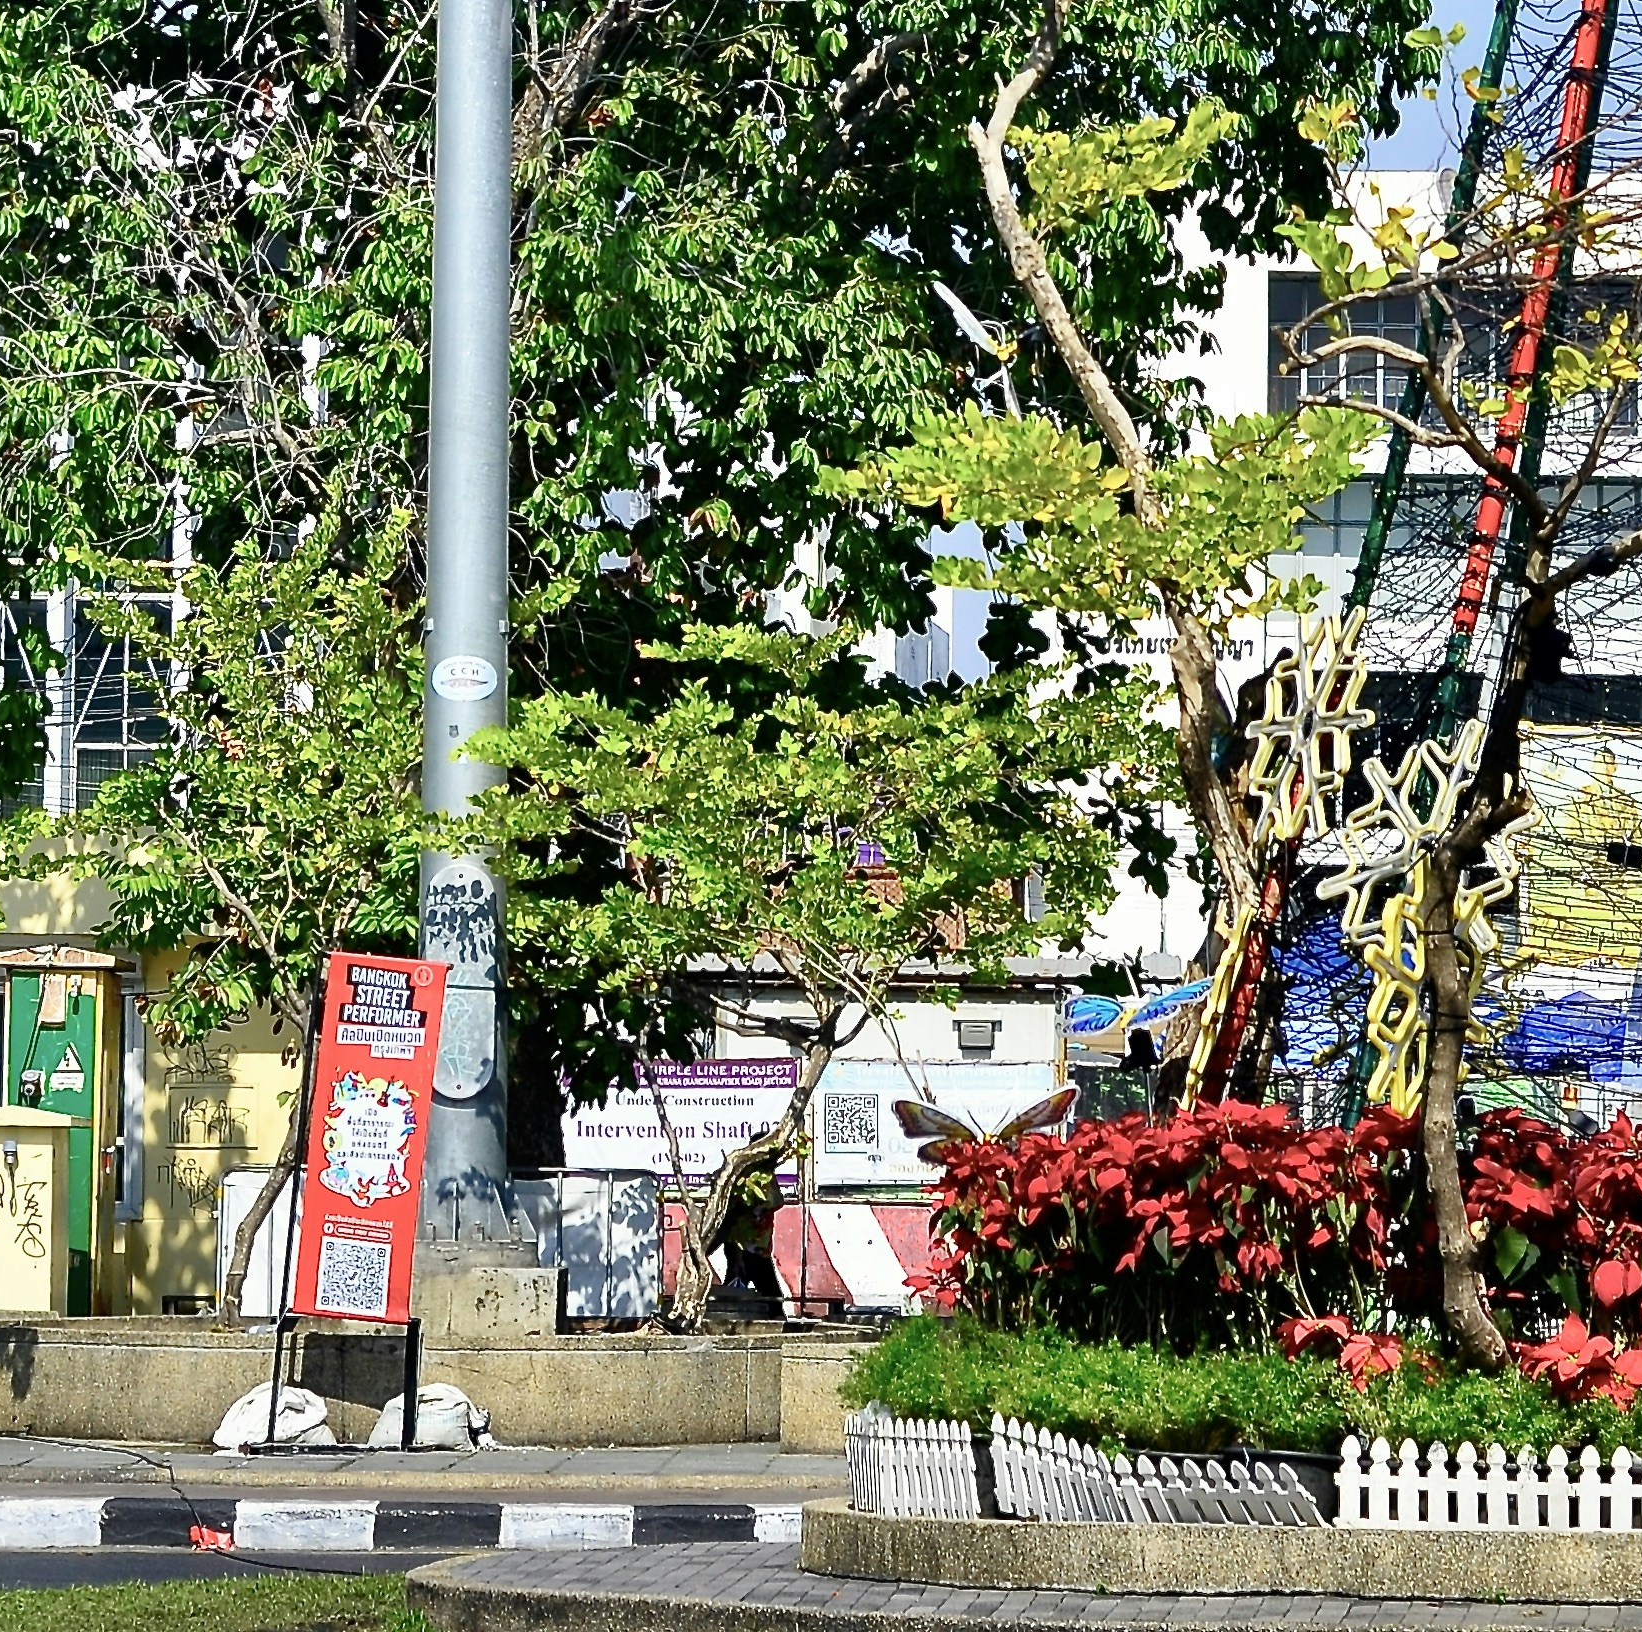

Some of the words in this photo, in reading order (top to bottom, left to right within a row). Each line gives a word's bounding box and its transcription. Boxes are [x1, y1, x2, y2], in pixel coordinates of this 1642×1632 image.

[351, 966, 408, 990] BANGKOK
[356, 985, 411, 1009] STREET
[343, 1004, 421, 1028] PERFORMER
[696, 1065, 727, 1076] LINE
[731, 1064, 793, 1076] PROJECT
[615, 1093, 658, 1106] Unde
[664, 1094, 754, 1106] Construction
[577, 1120, 695, 1139] Intervenon
[702, 1120, 753, 1139] Shaft
